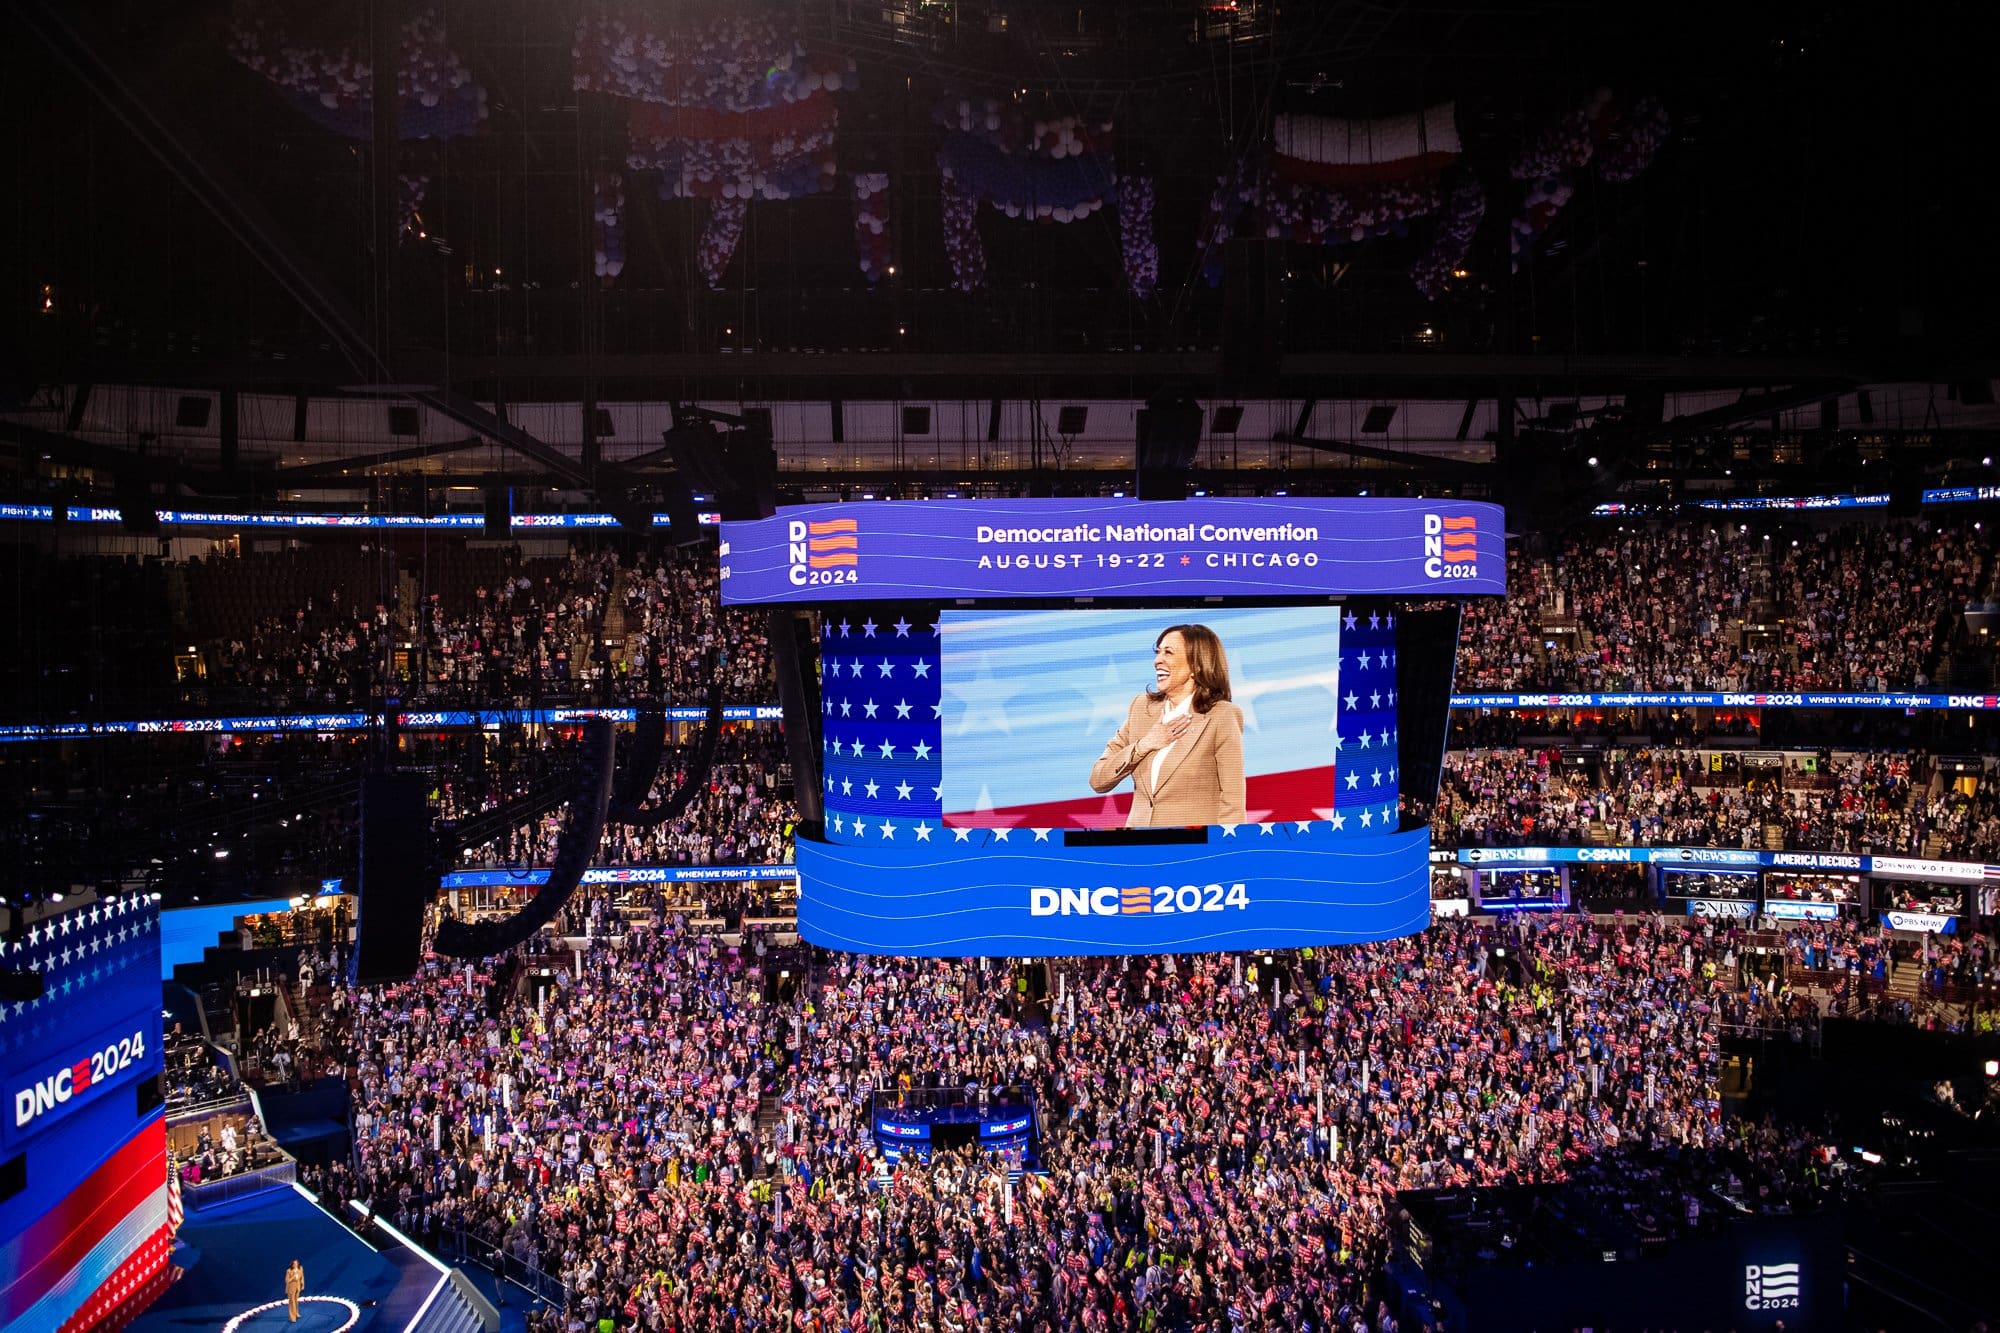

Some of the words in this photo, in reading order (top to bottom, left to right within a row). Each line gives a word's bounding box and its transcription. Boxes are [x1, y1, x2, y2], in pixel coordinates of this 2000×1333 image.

[1856, 496, 1882, 504] WHEN
[180, 513, 207, 521] WHEN
[208, 513, 223, 521] WE
[224, 514, 249, 522] FIGHT
[533, 515, 565, 526] 2024
[977, 523, 1100, 543] Democratic
[1105, 523, 1194, 542] National
[1199, 523, 1318, 541] Convention
[789, 520, 806, 585] DNC
[809, 569, 858, 584] 2024
[1424, 514, 1442, 577] DNC
[1443, 564, 1477, 578] 2024
[977, 553, 1083, 569] AUGUST
[1096, 553, 1166, 568] 19-22
[1205, 552, 1319, 568] CHICAGO
[1482, 697, 1495, 705] WE
[1496, 697, 1513, 705] WIN
[1519, 695, 1549, 706] DNC
[1558, 694, 1592, 705] 2024
[1643, 695, 1667, 703] FIGHT
[1679, 695, 1693, 703] WE
[1695, 695, 1713, 703] WIN
[1723, 695, 1756, 705] DNC
[1767, 694, 1803, 705] 2024
[1808, 696, 1837, 704] WHEN
[1838, 696, 1853, 704] WE
[1854, 696, 1882, 704] FIGHT
[1895, 697, 1910, 705] WE
[1948, 696, 1984, 708] DNC
[733, 709, 751, 718] WIN
[756, 707, 784, 719] DNC
[184, 720, 223, 732] 2024
[1482, 849, 1516, 860] NEWS
[1577, 848, 1630, 861] C-SPAN
[1693, 850, 1727, 861] NEWS
[1773, 853, 1818, 867] AMERICA
[1819, 855, 1860, 868] DECIDES
[584, 869, 617, 882] DNC
[629, 869, 666, 882] 2024
[676, 870, 704, 879] WHEN
[705, 869, 720, 878] WE
[721, 869, 748, 879] FIGHT
[760, 868, 775, 877] WE
[776, 867, 795, 877] WIN
[1029, 887, 1119, 916] DNC
[1153, 883, 1250, 914] 2024
[1707, 902, 1750, 914] NEWS
[1904, 918, 1919, 926] PBS
[1920, 920, 1943, 928] NEWS
[15, 1067, 72, 1127] DNC
[90, 1031, 145, 1084] 2024
[882, 1123, 895, 1134] DNC
[900, 1126, 920, 1136] 2024
[990, 1124, 1008, 1134] DNC
[1012, 1119, 1027, 1131] 2024
[1745, 1265, 1761, 1309] DNC
[1762, 1298, 1799, 1309] 2024
